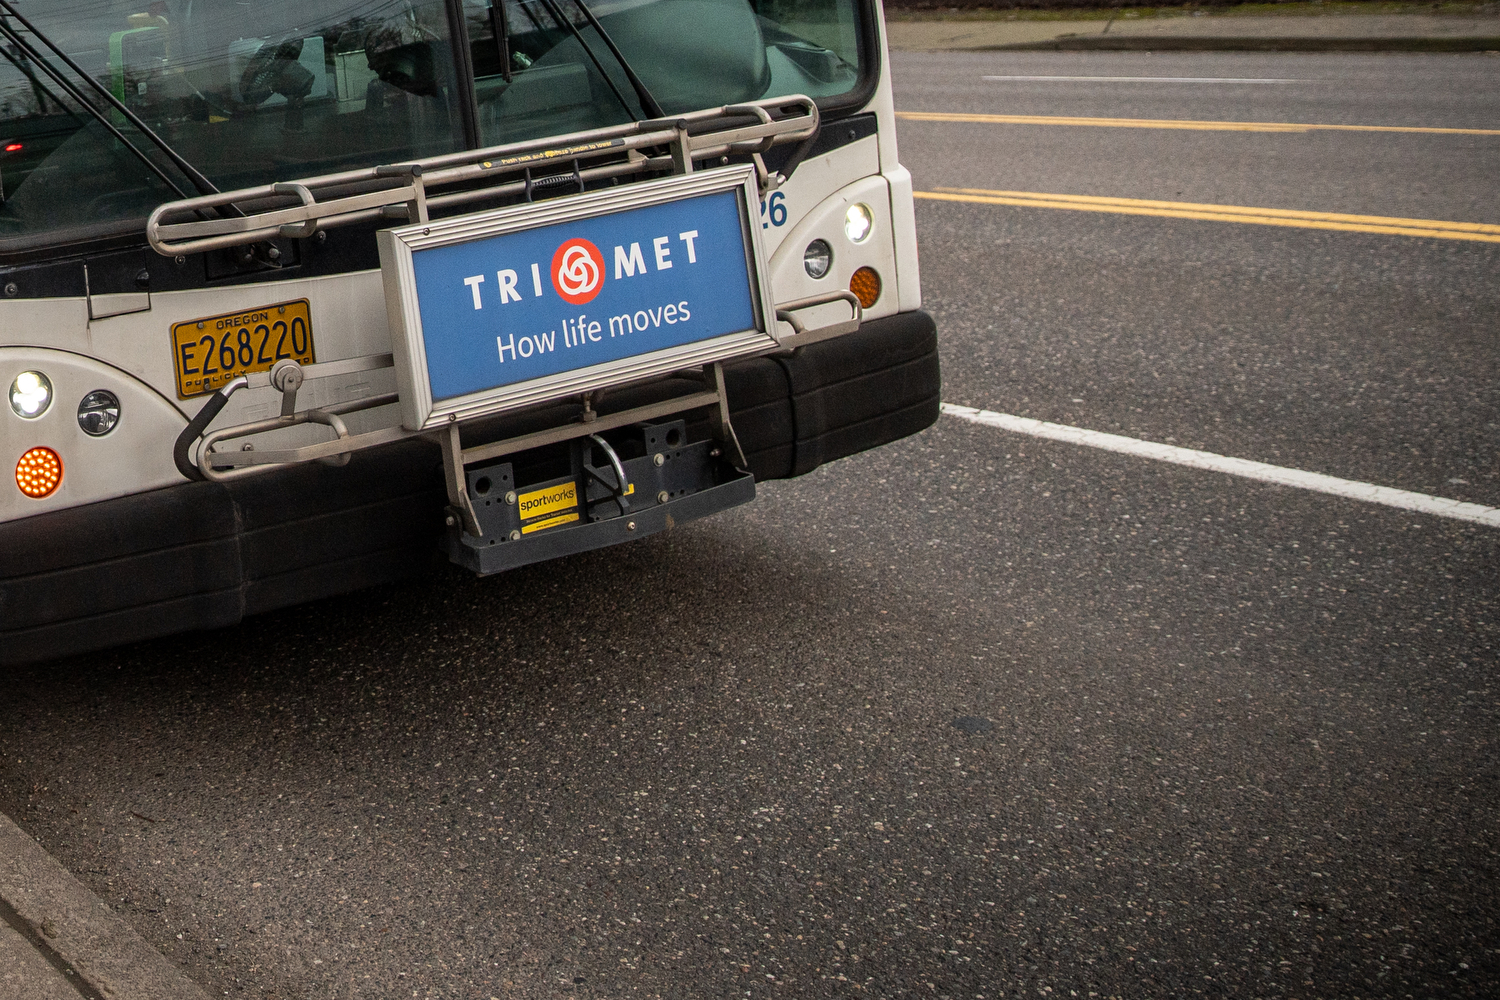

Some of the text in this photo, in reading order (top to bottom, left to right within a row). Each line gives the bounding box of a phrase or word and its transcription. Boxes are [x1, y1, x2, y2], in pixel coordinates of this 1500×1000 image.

[464, 230, 699, 310] TRI MET
[180, 316, 308, 376] E268220
[216, 312, 269, 330] OREGON
[496, 301, 691, 363] How life moves
[520, 488, 575, 512] sportworks
